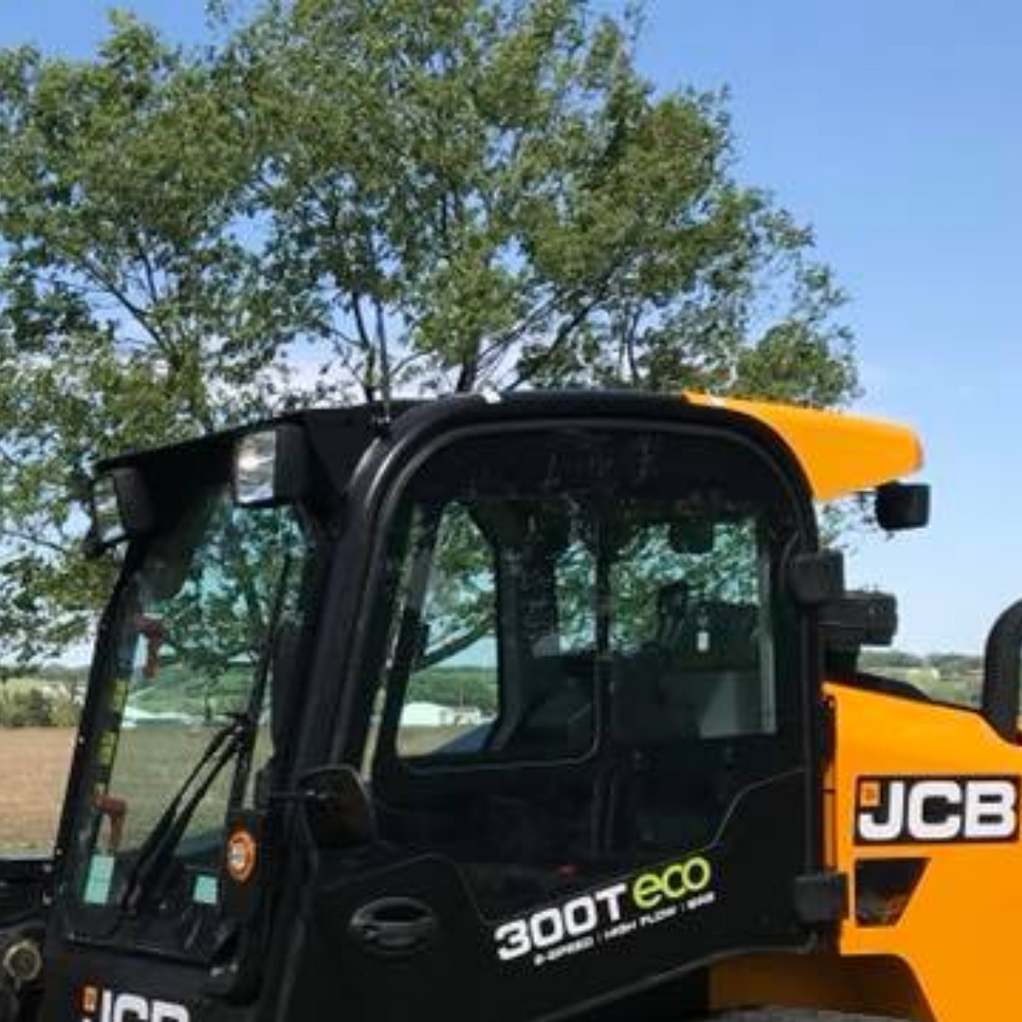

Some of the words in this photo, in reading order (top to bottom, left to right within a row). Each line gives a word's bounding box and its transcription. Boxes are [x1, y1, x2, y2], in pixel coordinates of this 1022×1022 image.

[859, 780, 1017, 840] JCB
[494, 883, 626, 960] 300T
[633, 857, 711, 909] eco
